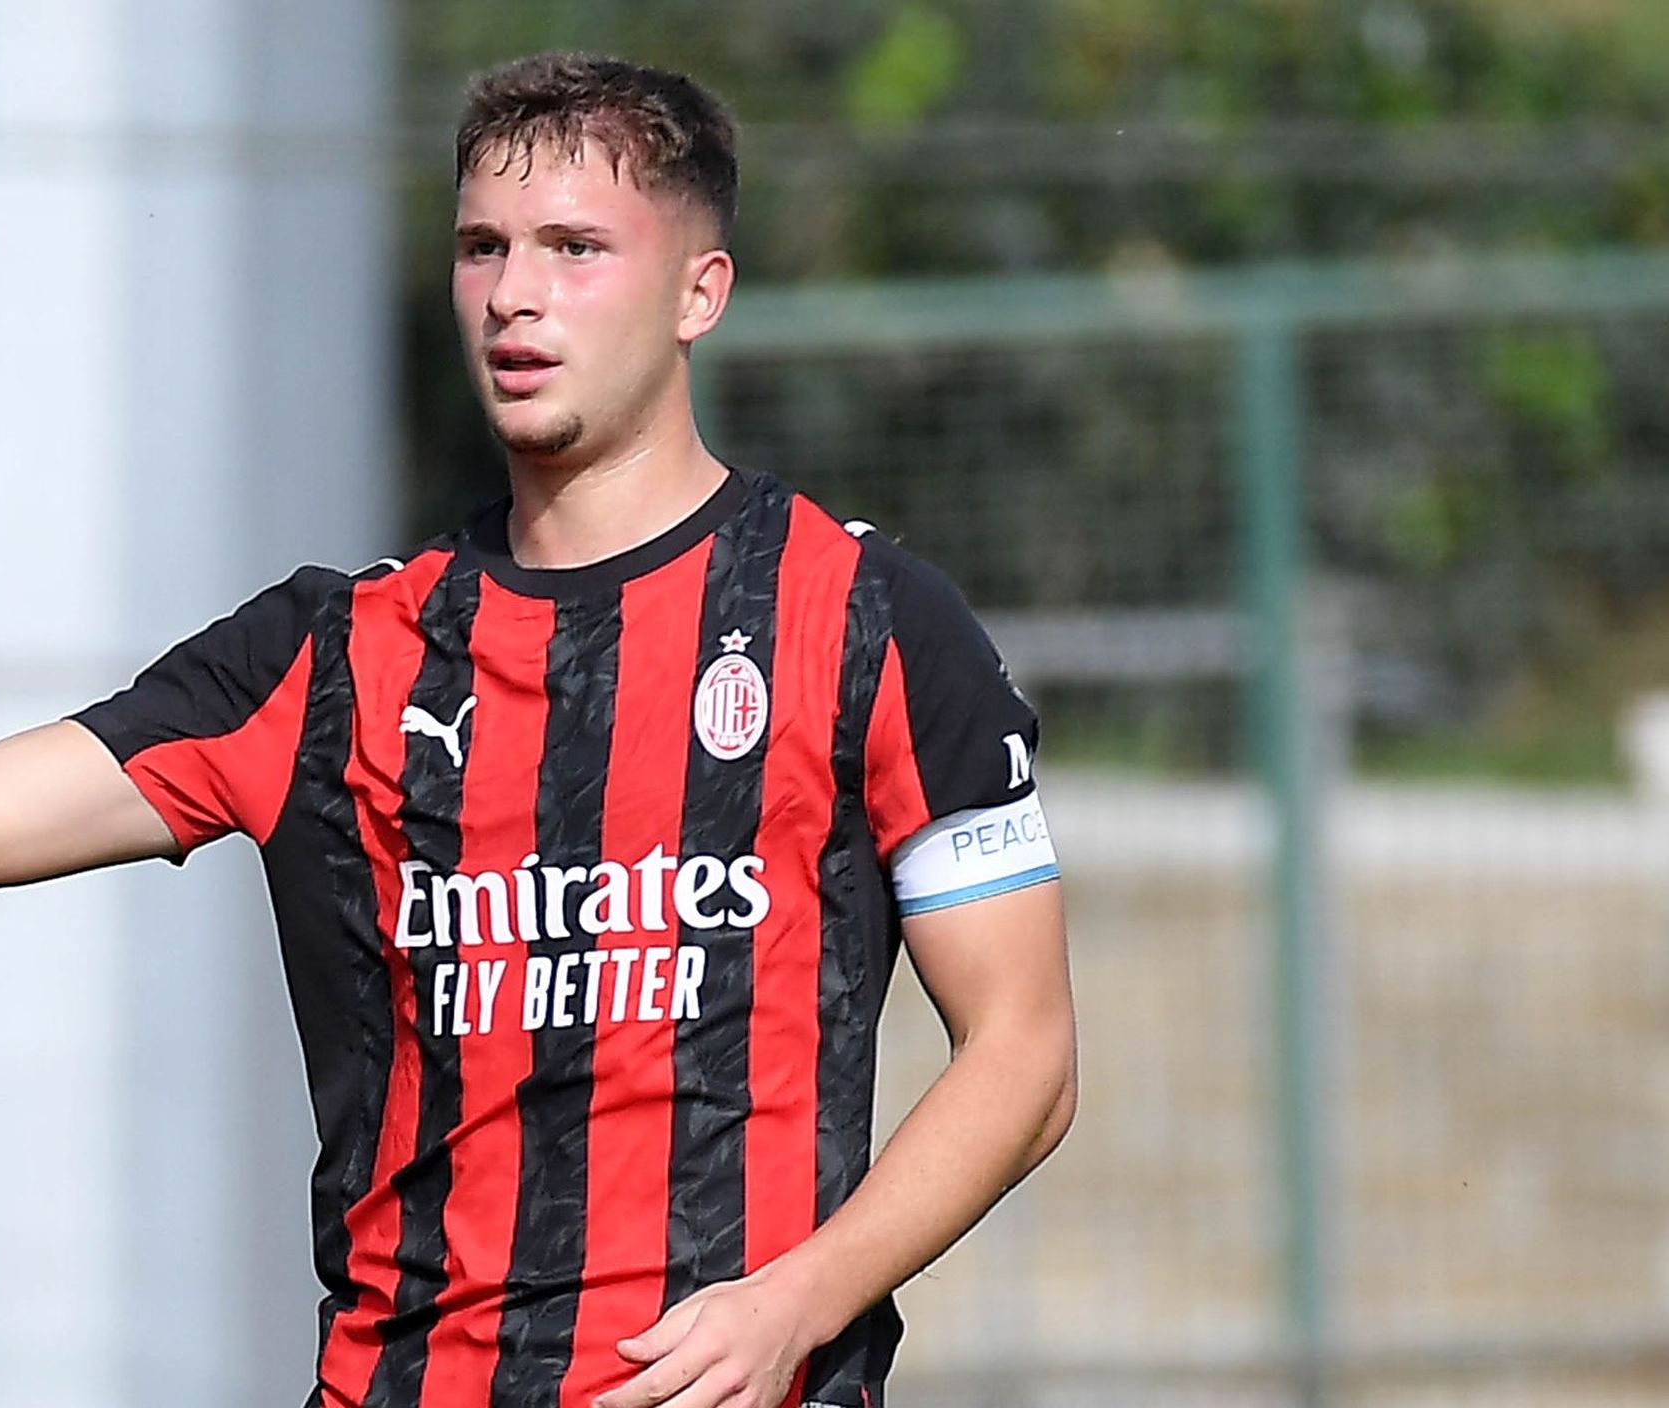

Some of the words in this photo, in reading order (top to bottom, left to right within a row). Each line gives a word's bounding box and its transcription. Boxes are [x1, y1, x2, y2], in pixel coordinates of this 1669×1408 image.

[394, 843, 771, 949] Emirates
[433, 959, 508, 1036] FLY
[521, 945, 707, 1031] BETTER
